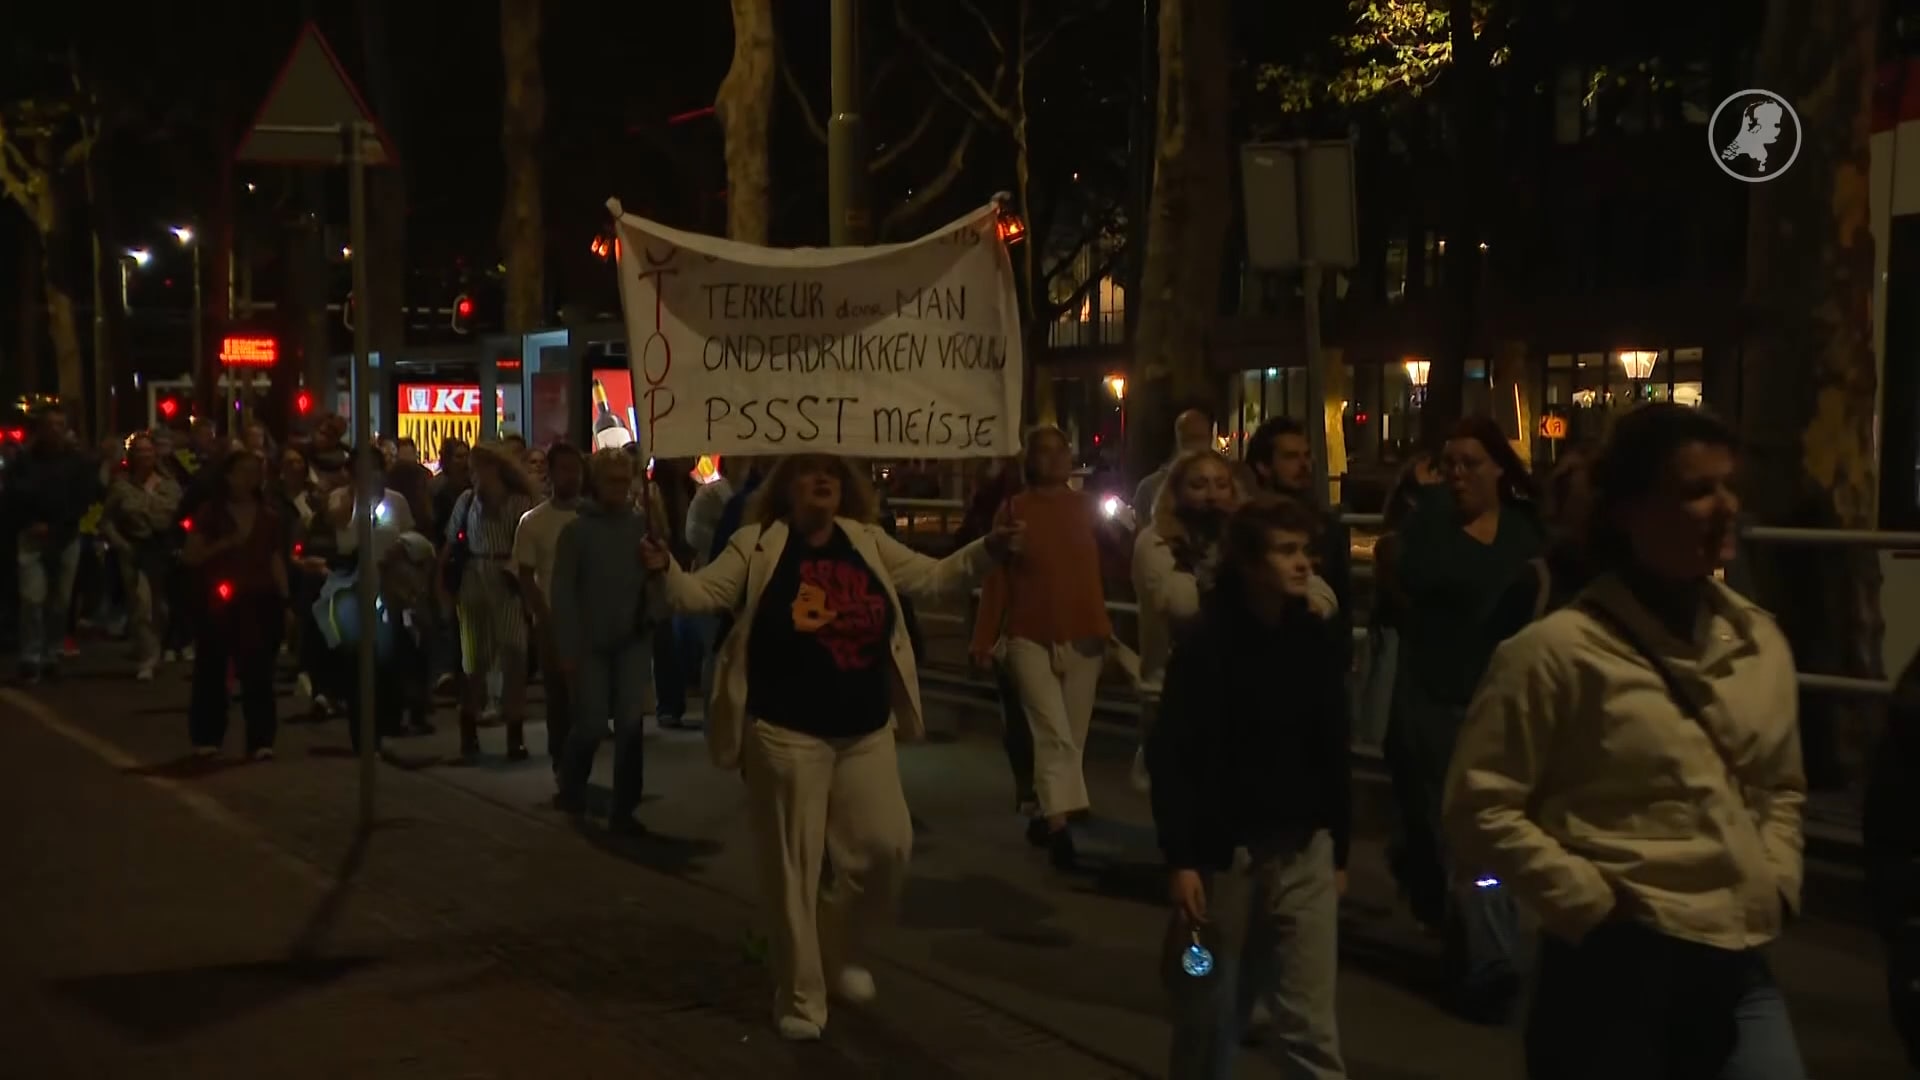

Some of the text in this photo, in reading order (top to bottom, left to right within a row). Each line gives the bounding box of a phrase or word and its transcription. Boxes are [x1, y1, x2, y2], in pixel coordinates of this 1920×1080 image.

[702, 281, 824, 320] TERREUR
[896, 285, 965, 320] MAN
[703, 332, 927, 373] ONDERDRUKKEN
[705, 395, 859, 443] PSSST
